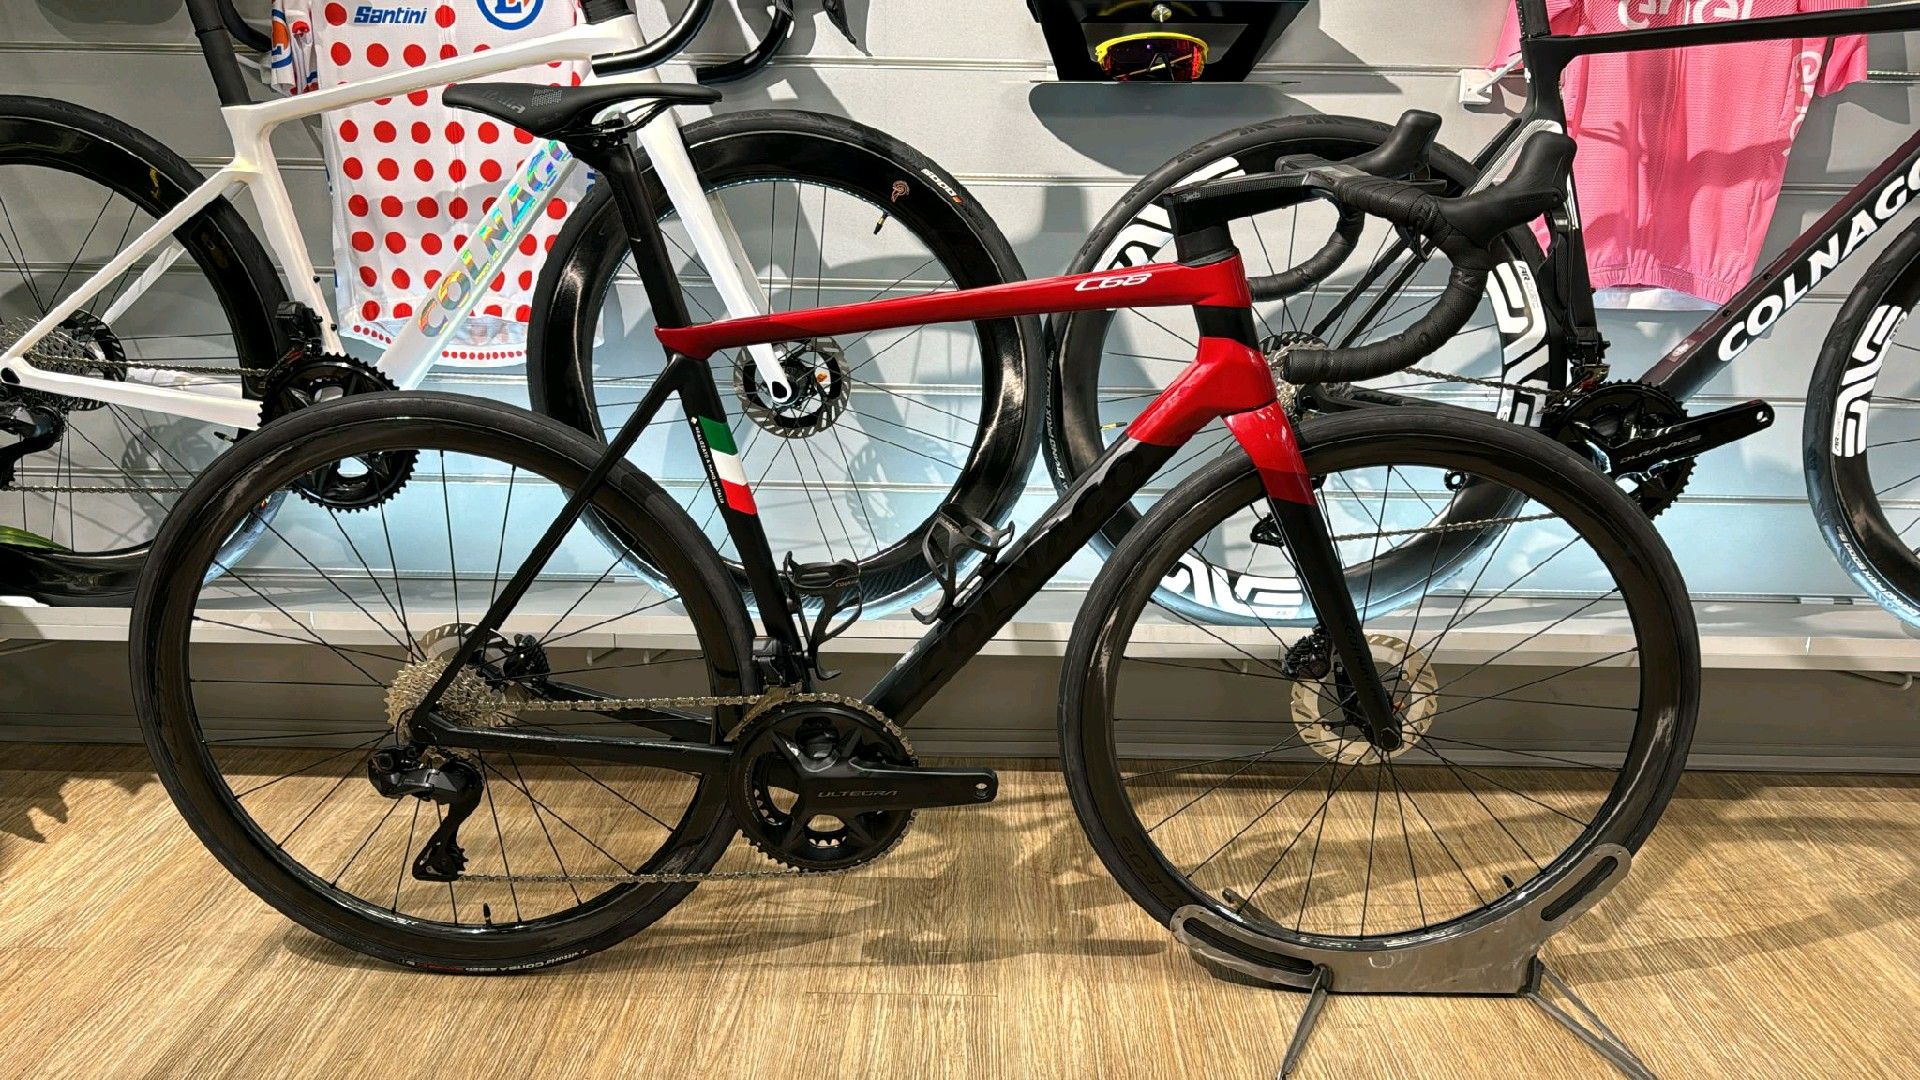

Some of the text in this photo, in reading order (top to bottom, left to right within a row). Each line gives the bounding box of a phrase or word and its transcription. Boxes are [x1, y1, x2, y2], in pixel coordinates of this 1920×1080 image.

[354, 6, 427, 24] Santini
[1074, 273, 1153, 292] C68
[817, 790, 898, 798] ULTEGRA
